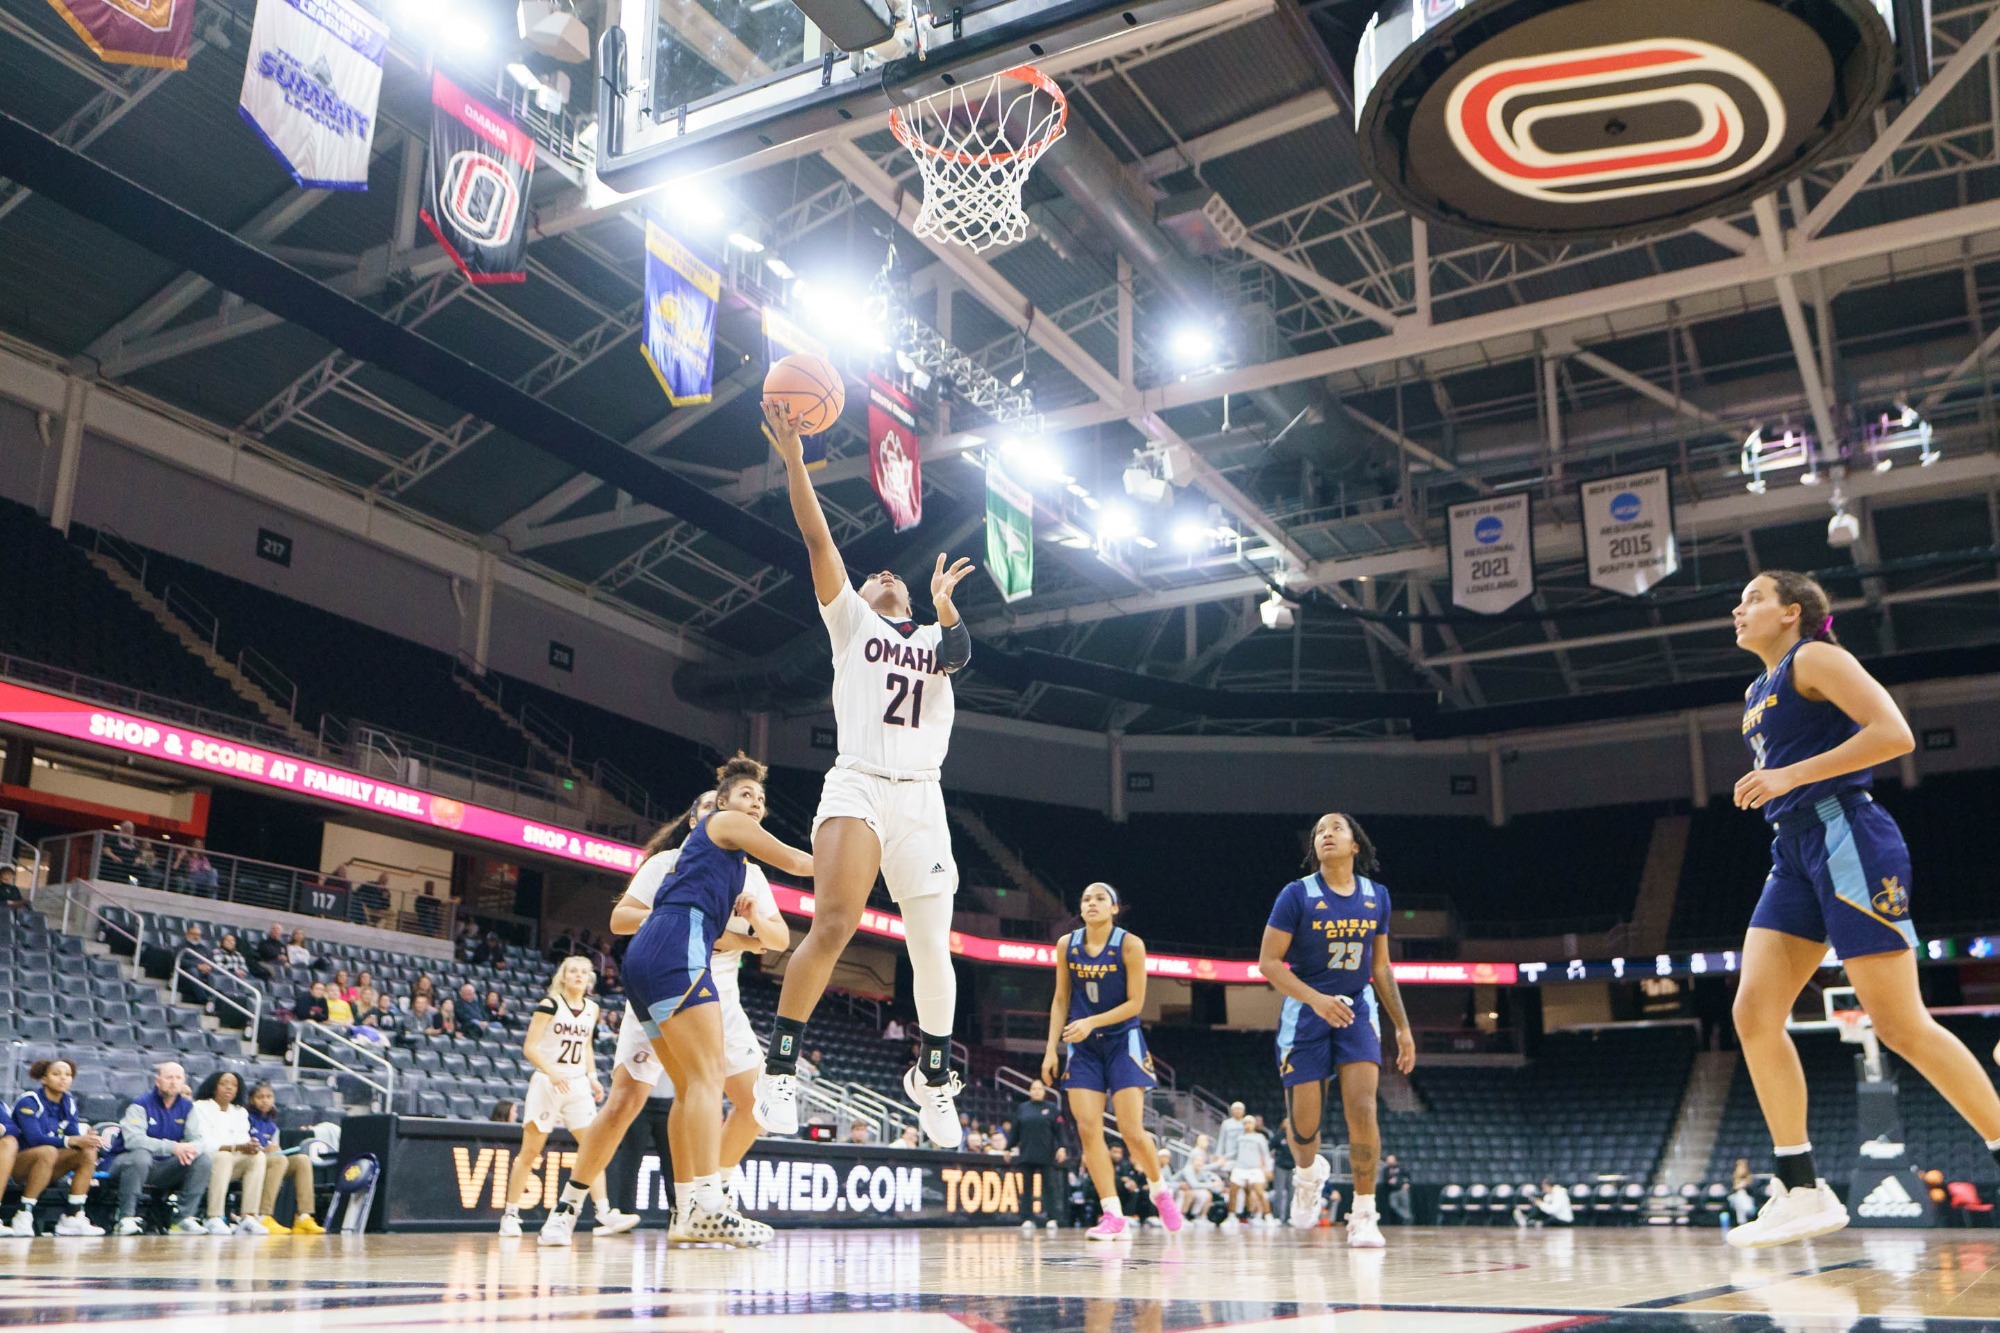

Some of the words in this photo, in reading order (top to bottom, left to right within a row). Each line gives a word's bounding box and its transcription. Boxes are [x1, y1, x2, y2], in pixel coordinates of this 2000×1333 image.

[259, 51, 370, 141] SUMMIT
[284, 92, 344, 137] LEAGUE
[464, 103, 508, 143] OMAHA
[1609, 533, 1653, 559] 2015
[1471, 557, 1510, 580] 2021
[883, 672, 925, 728] 21
[89, 713, 160, 748] SHOP
[164, 733, 183, 756] &
[190, 739, 266, 775] SCORE
[269, 760, 298, 783] AT
[303, 768, 374, 802] FAMILY
[374, 786, 424, 815] FARE.
[523, 825, 567, 850] SHOP
[568, 837, 581, 855] &
[584, 841, 632, 868] SCORE
[312, 891, 336, 910] 117
[1312, 918, 1378, 930] KANSAS
[1326, 928, 1367, 939] CITY
[1069, 962, 1118, 972] KANSAS
[1327, 941, 1364, 971] 23
[1077, 970, 1106, 978] CITY
[1085, 981, 1099, 1003] 0
[556, 1039, 583, 1065] 20
[453, 1147, 578, 1209] VISI
[941, 1168, 1043, 1214] TODA!
